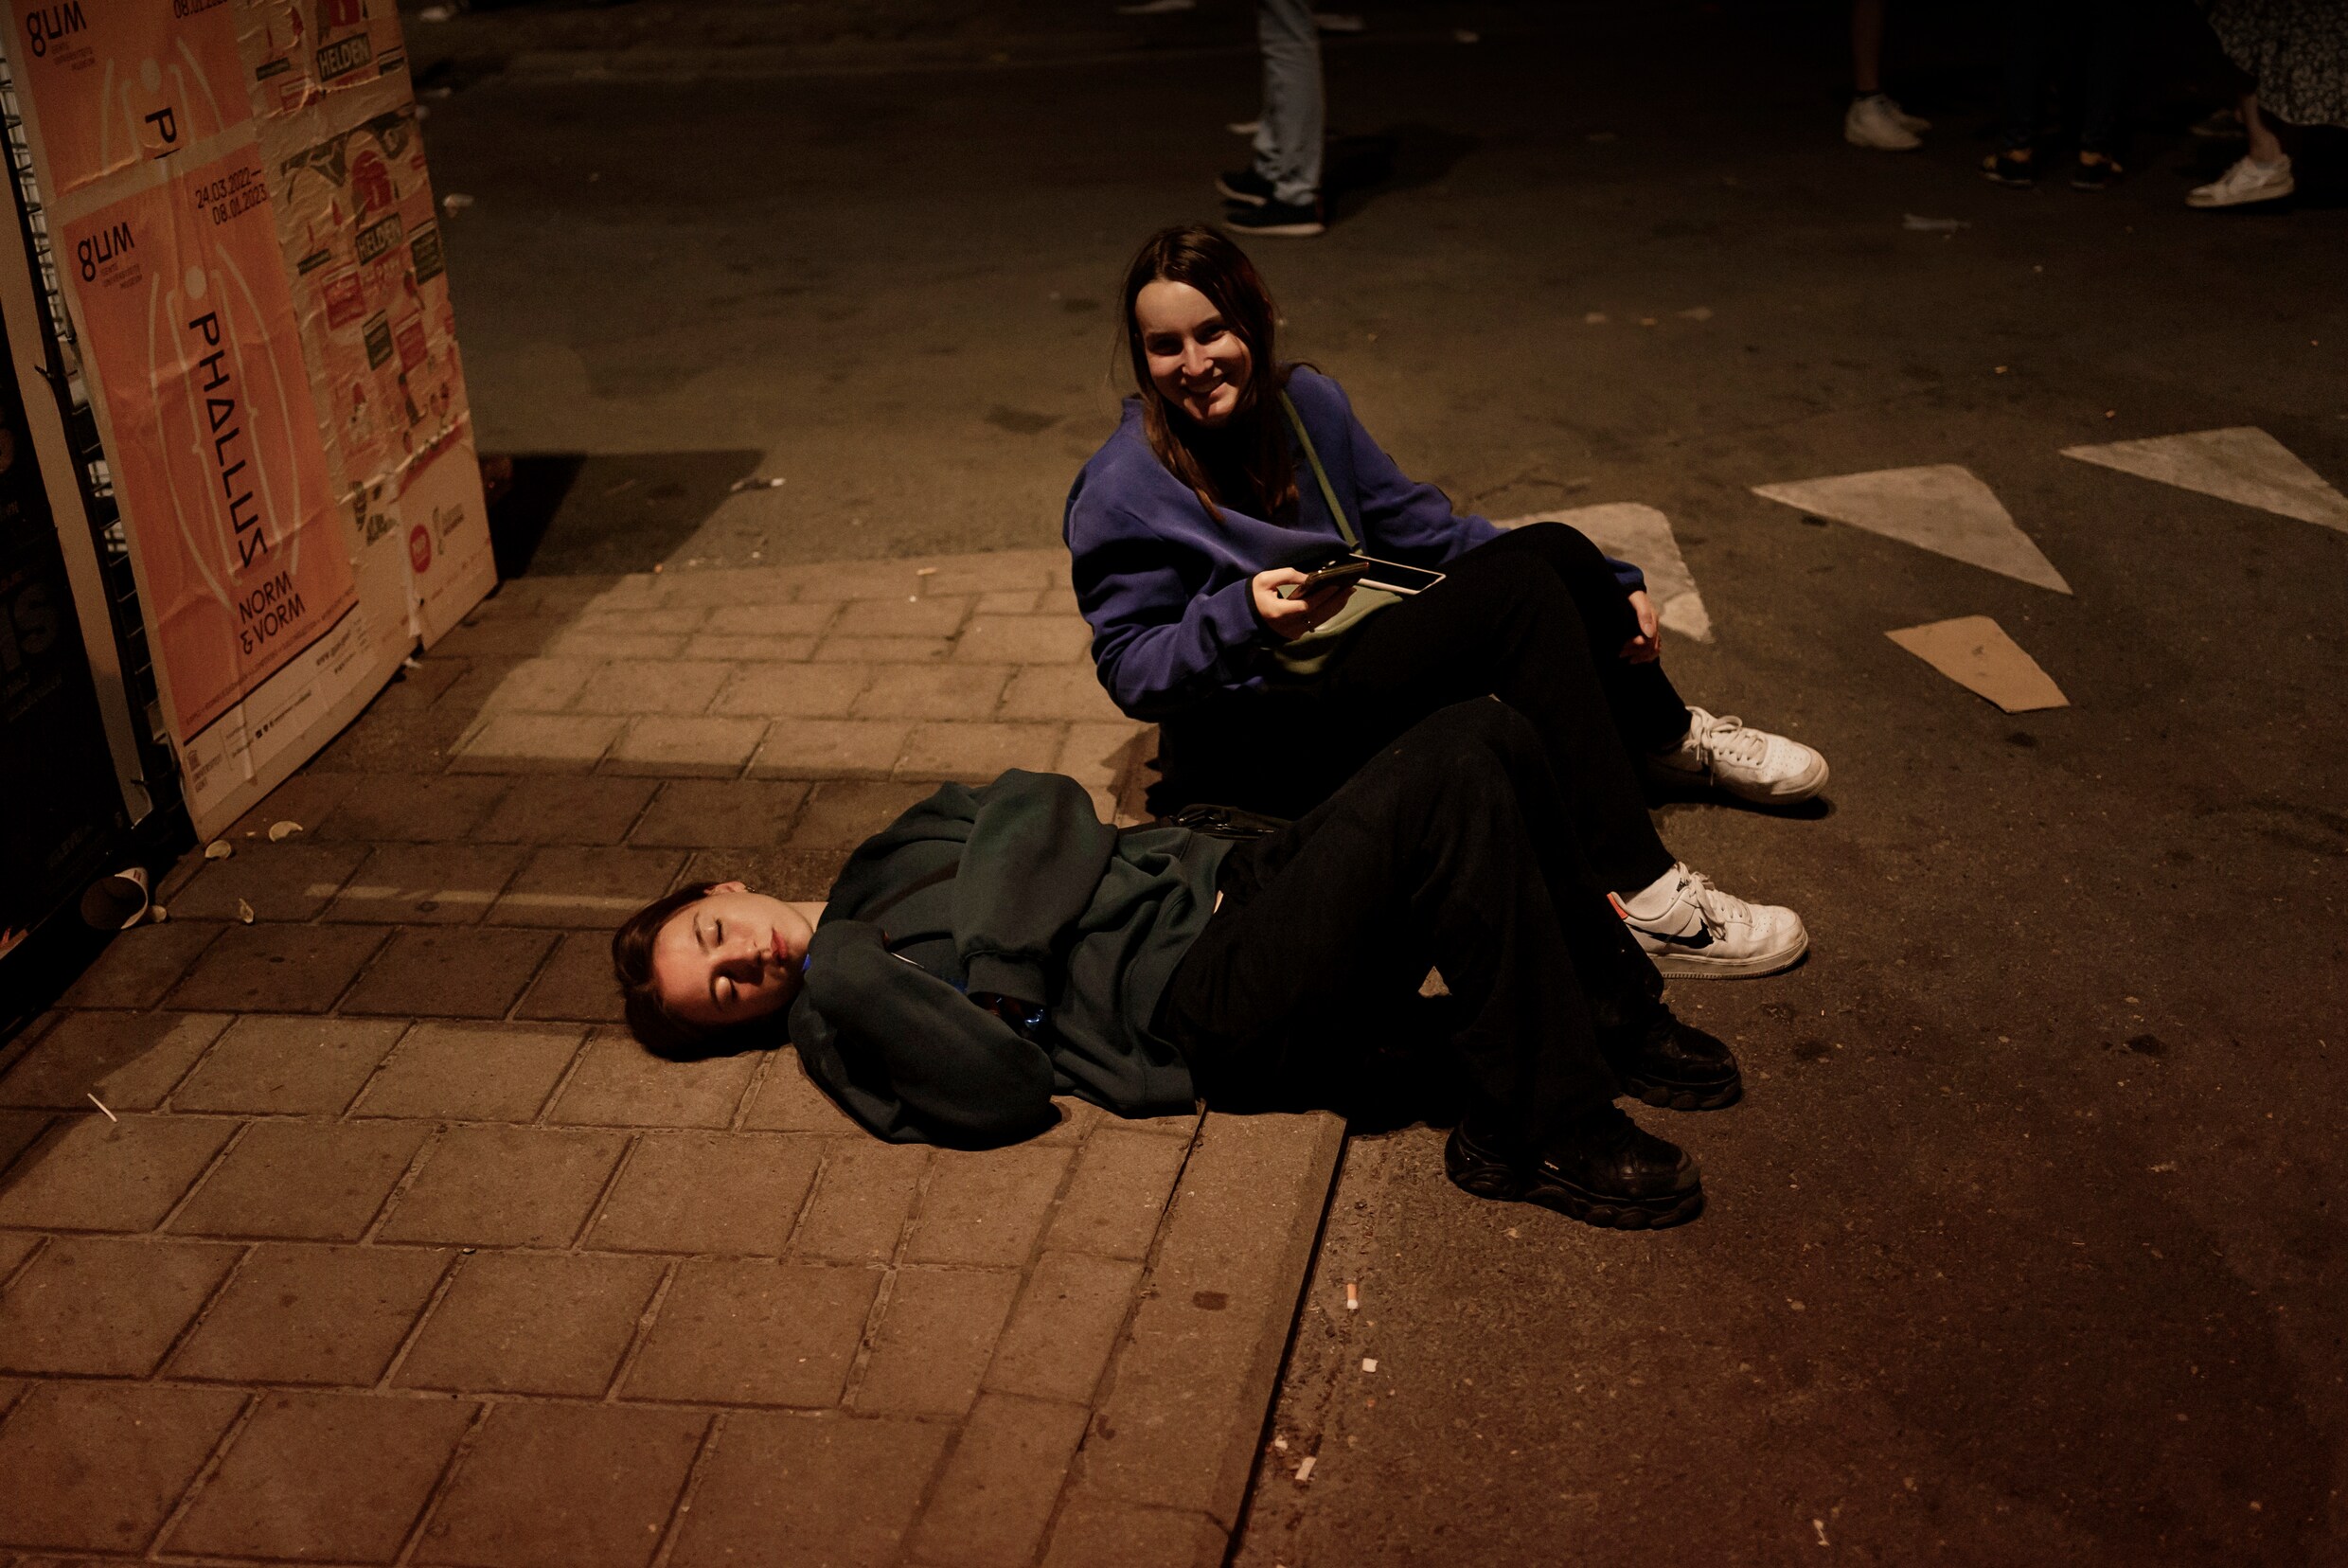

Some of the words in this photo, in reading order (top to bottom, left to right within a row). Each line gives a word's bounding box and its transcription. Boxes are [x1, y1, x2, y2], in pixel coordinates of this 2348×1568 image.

[318, 35, 371, 79] HELDEN
[145, 106, 183, 160] P
[212, 183, 268, 225] 08.01.2023
[356, 216, 402, 261] HELDEN
[239, 570, 294, 625] NORM
